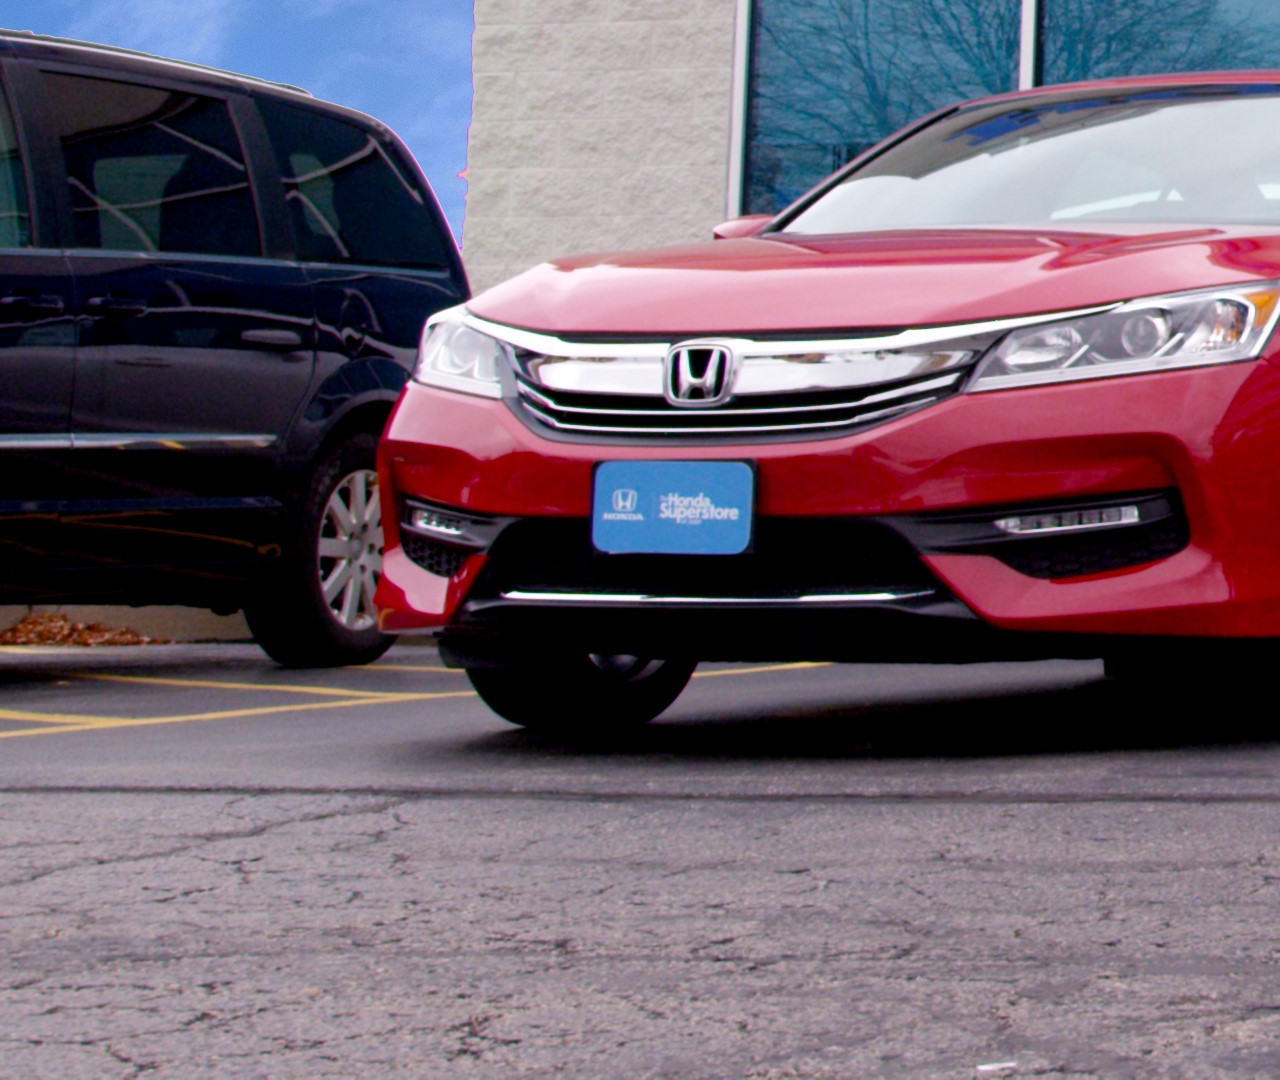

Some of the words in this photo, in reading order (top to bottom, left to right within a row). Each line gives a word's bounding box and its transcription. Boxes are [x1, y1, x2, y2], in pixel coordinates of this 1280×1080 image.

[668, 492, 711, 507] Honda
[602, 512, 645, 521] HONDA
[658, 502, 739, 524] Superstore
